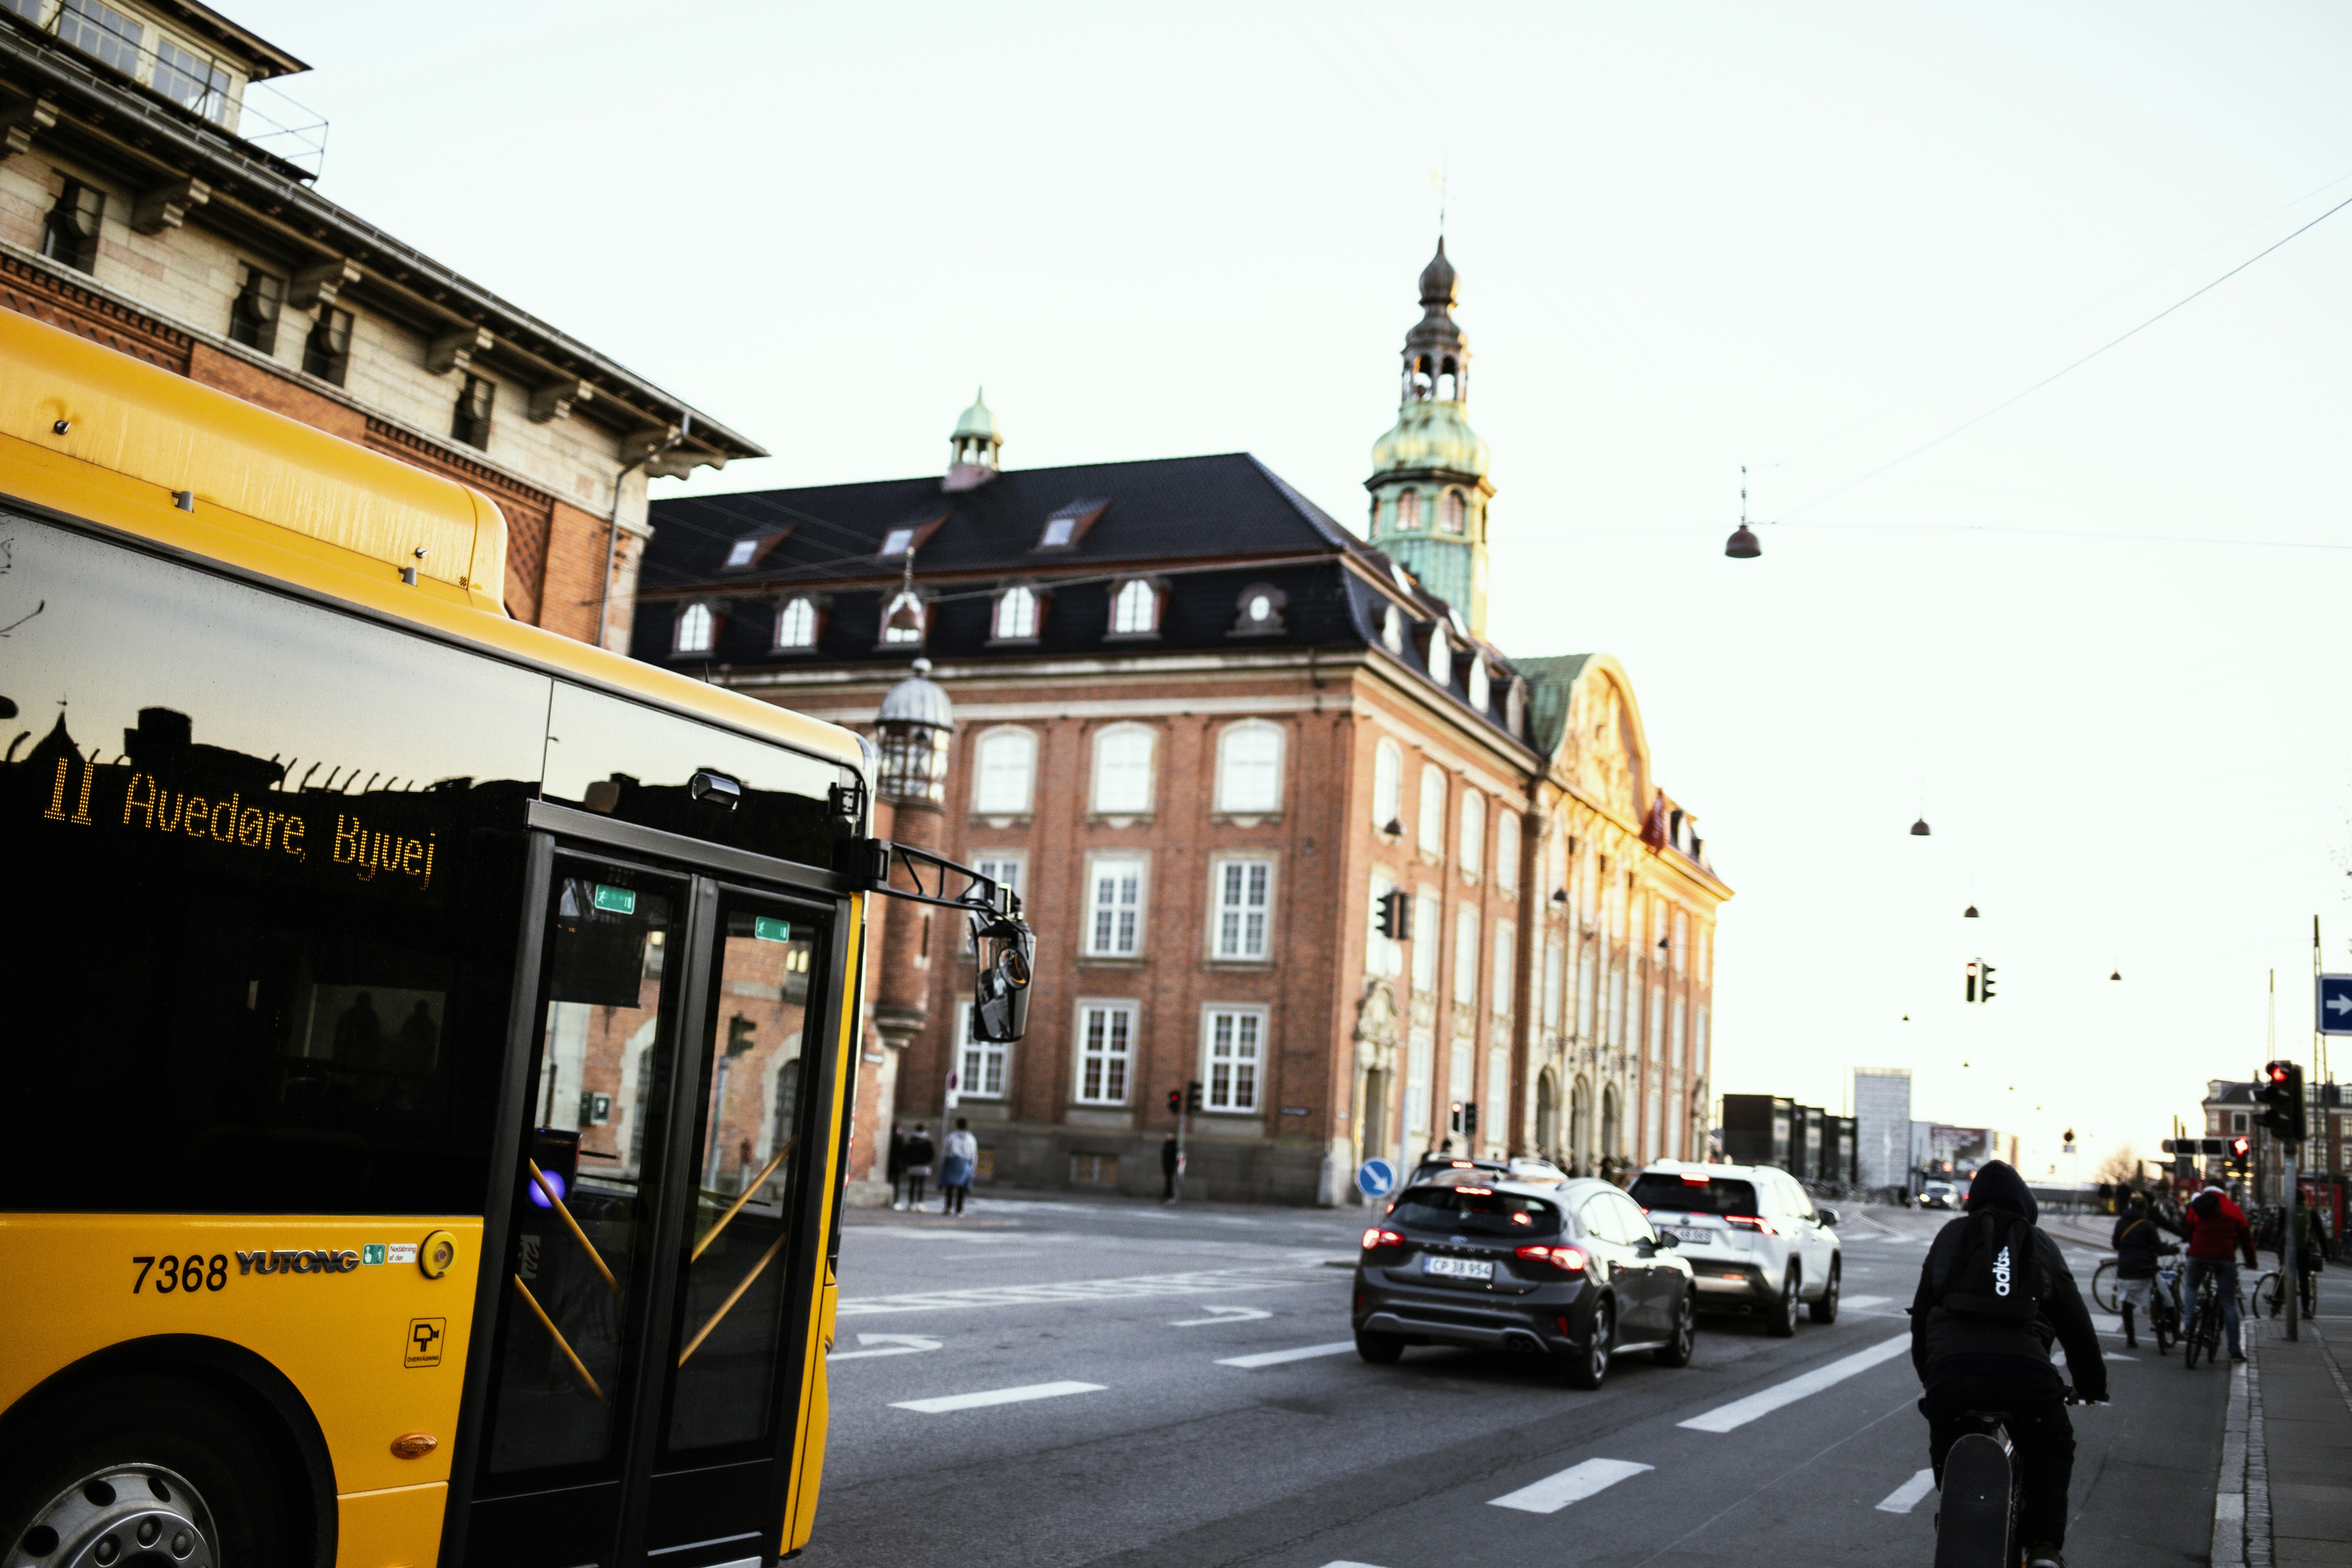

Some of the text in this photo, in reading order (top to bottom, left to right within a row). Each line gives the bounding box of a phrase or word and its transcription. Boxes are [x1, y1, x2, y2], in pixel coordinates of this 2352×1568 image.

[44, 756, 93, 825] 11
[334, 814, 436, 890] Byvej
[132, 1254, 228, 1294] 7368
[236, 1250, 360, 1275] YUTONG
[1433, 1260, 1449, 1271] CP
[1992, 1246, 2011, 1296] adidas
